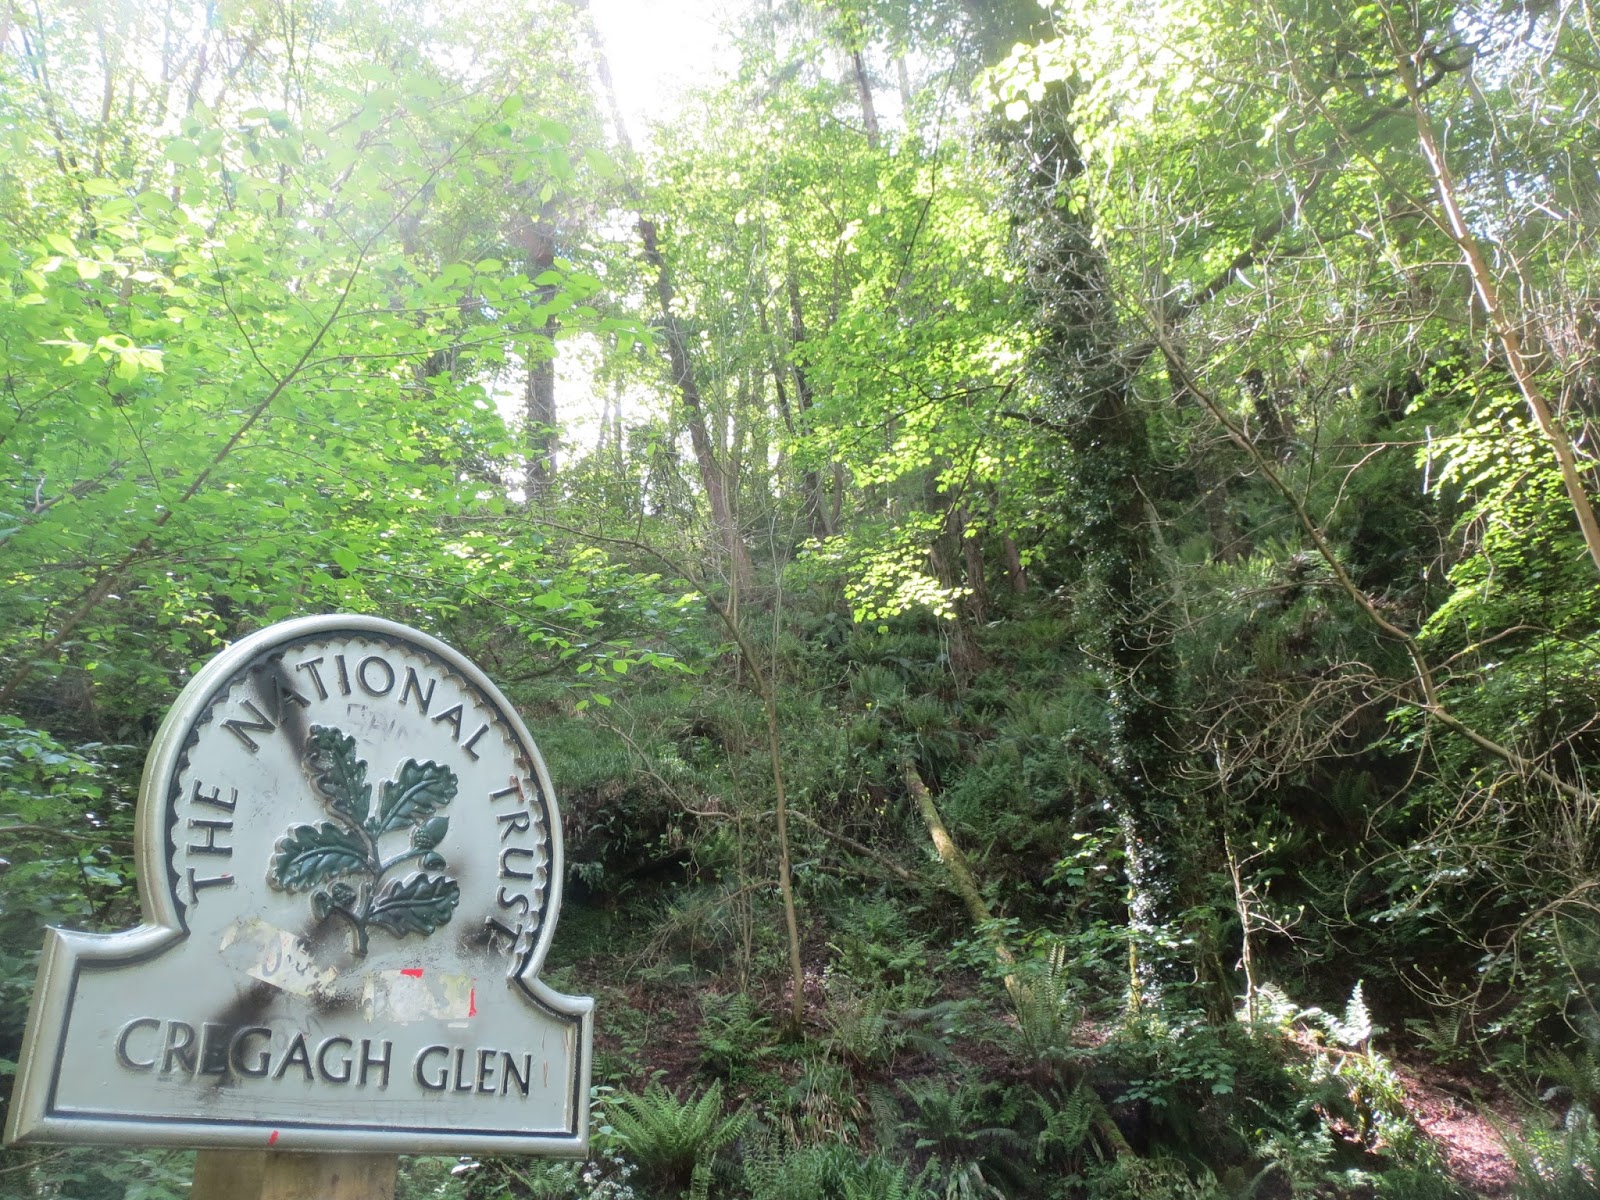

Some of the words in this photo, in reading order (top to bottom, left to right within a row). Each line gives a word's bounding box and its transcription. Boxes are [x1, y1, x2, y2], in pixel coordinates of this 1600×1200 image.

[186, 778, 239, 904] THE
[219, 654, 491, 761] NATIONAL
[486, 775, 535, 951] TRUST
[116, 1018, 392, 1088] CREGAGH
[413, 1045, 532, 1096] GLEN
